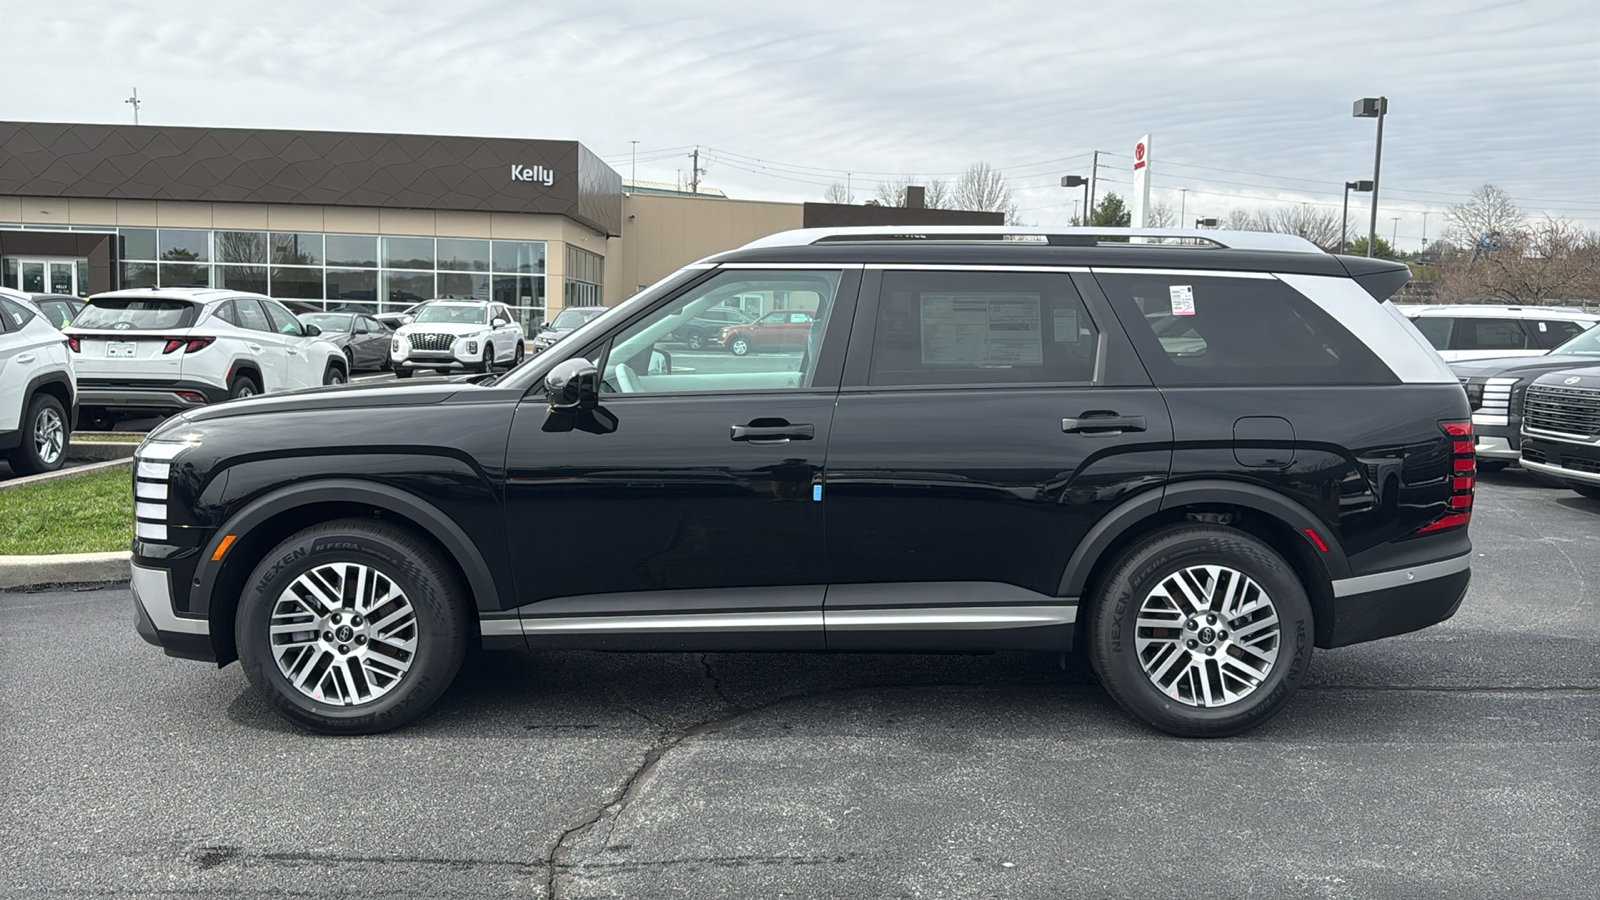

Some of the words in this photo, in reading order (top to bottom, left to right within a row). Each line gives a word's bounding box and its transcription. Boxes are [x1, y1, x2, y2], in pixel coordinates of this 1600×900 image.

[511, 164, 554, 186] Kelly
[255, 546, 306, 594] NEXEN
[1111, 591, 1132, 653] NEXEN
[1286, 619, 1306, 681] NEXEN
[378, 675, 430, 719] NEXEN
